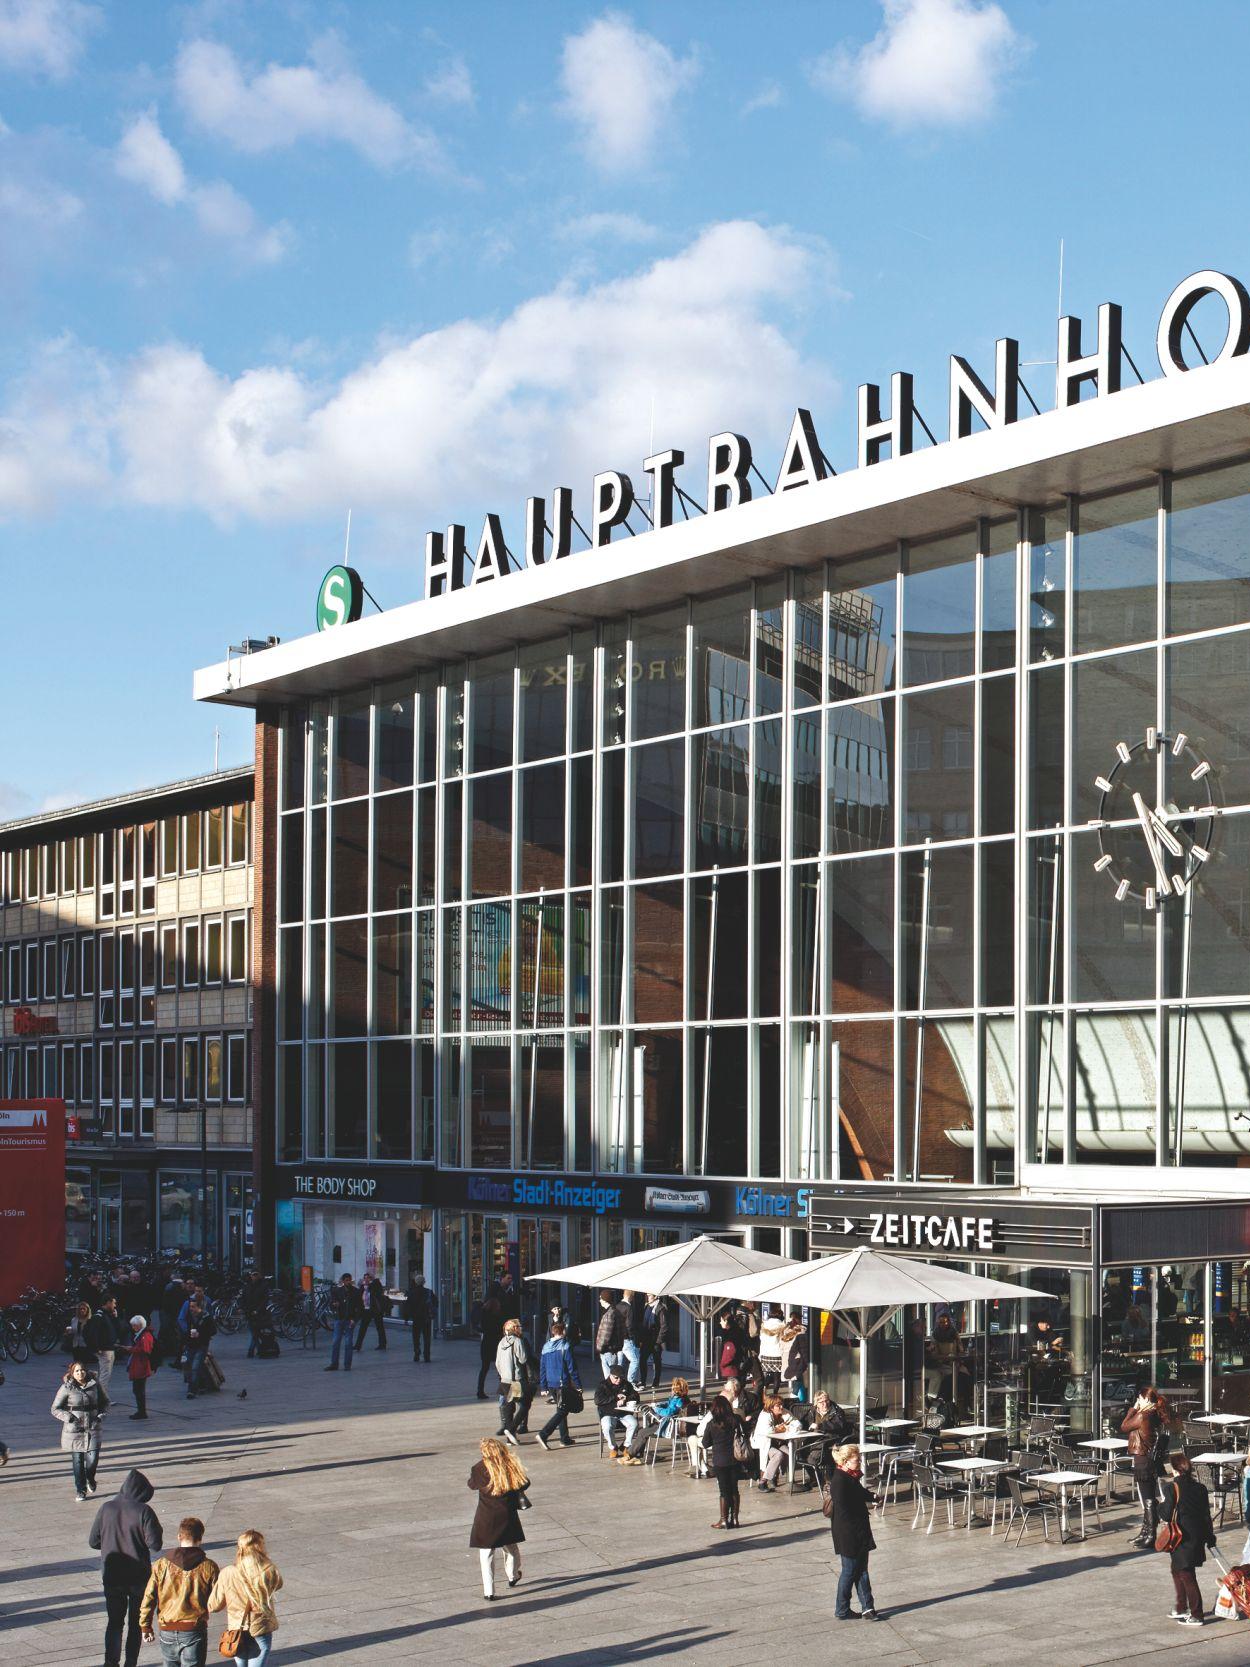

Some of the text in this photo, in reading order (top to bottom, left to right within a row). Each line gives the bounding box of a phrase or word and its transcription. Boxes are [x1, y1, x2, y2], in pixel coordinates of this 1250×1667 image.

[322, 575, 347, 631] S
[294, 1175, 376, 1197] THE BODY SHOP
[467, 1176, 622, 1214] Kölner Stadt-Anzeiger
[735, 1186, 793, 1217] Kölner
[869, 1213, 993, 1249] ZEITCAFE
